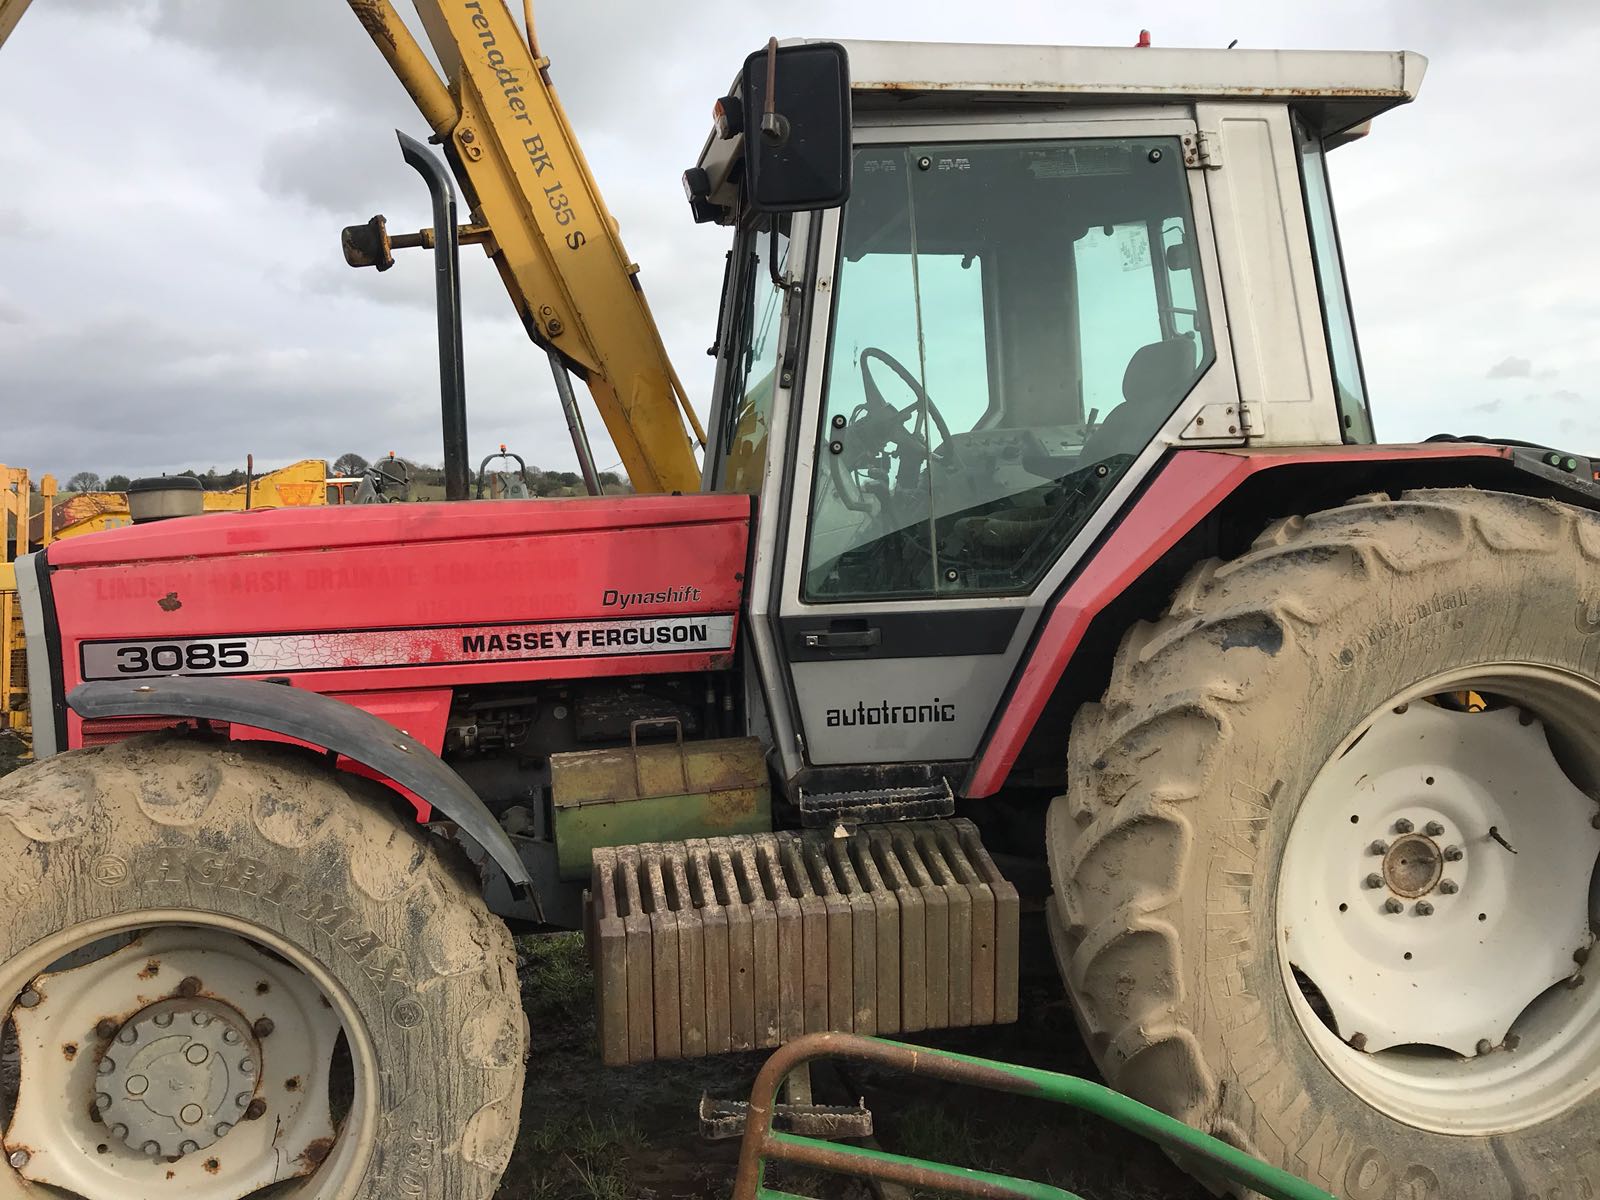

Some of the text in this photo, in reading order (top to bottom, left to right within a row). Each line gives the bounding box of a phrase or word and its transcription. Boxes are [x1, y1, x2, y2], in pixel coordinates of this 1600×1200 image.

[523, 133, 555, 177] BK
[544, 181, 576, 226] 135
[566, 231, 587, 251] S
[603, 585, 703, 609] Dynashift
[117, 623, 707, 673] 3085 MASSEY FERGUSON
[827, 698, 955, 727] autotronic
